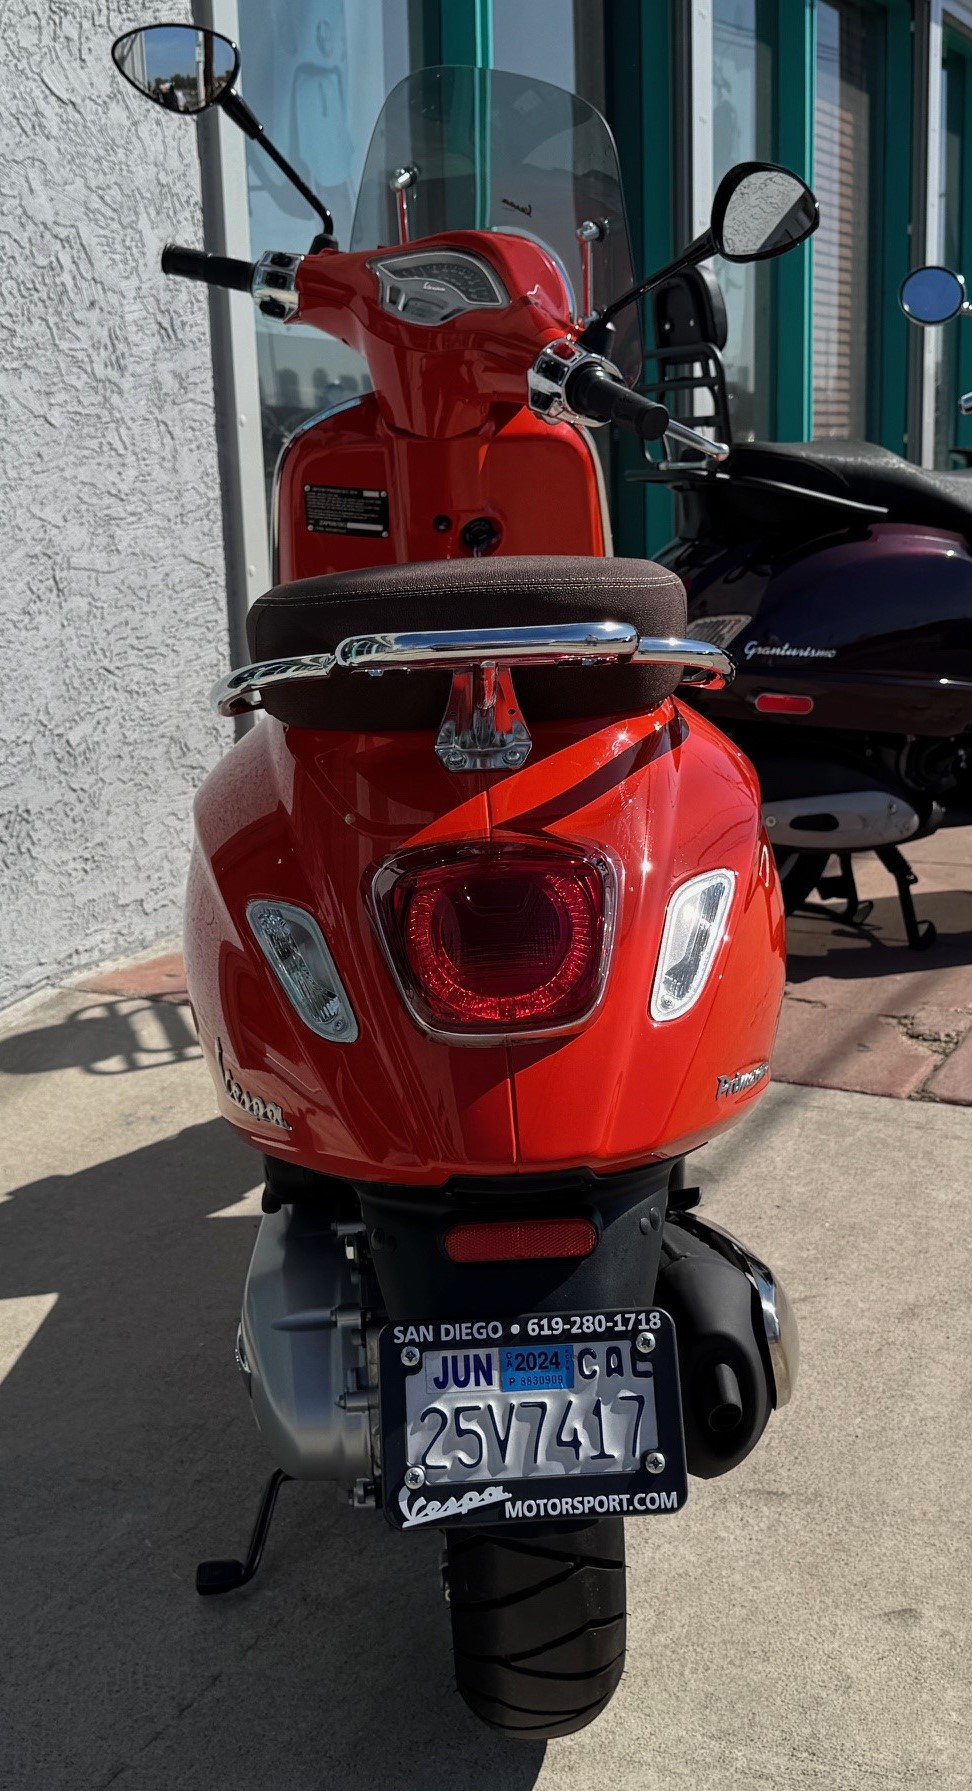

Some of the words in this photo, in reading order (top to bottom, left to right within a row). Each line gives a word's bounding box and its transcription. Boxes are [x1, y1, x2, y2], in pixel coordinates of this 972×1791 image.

[744, 640, 836, 660] Granturismo
[215, 1036, 293, 1130] Vespa
[393, 1325, 434, 1343] SAN
[440, 1321, 503, 1341] DIEGO
[527, 1312, 661, 1336] 619-280-1718
[433, 1353, 494, 1390] JUN
[514, 1351, 560, 1371] 2024
[420, 1395, 645, 1469] 25V7417
[398, 1485, 513, 1529] Vespa
[504, 1491, 678, 1518] MOTORSPORT.COM
